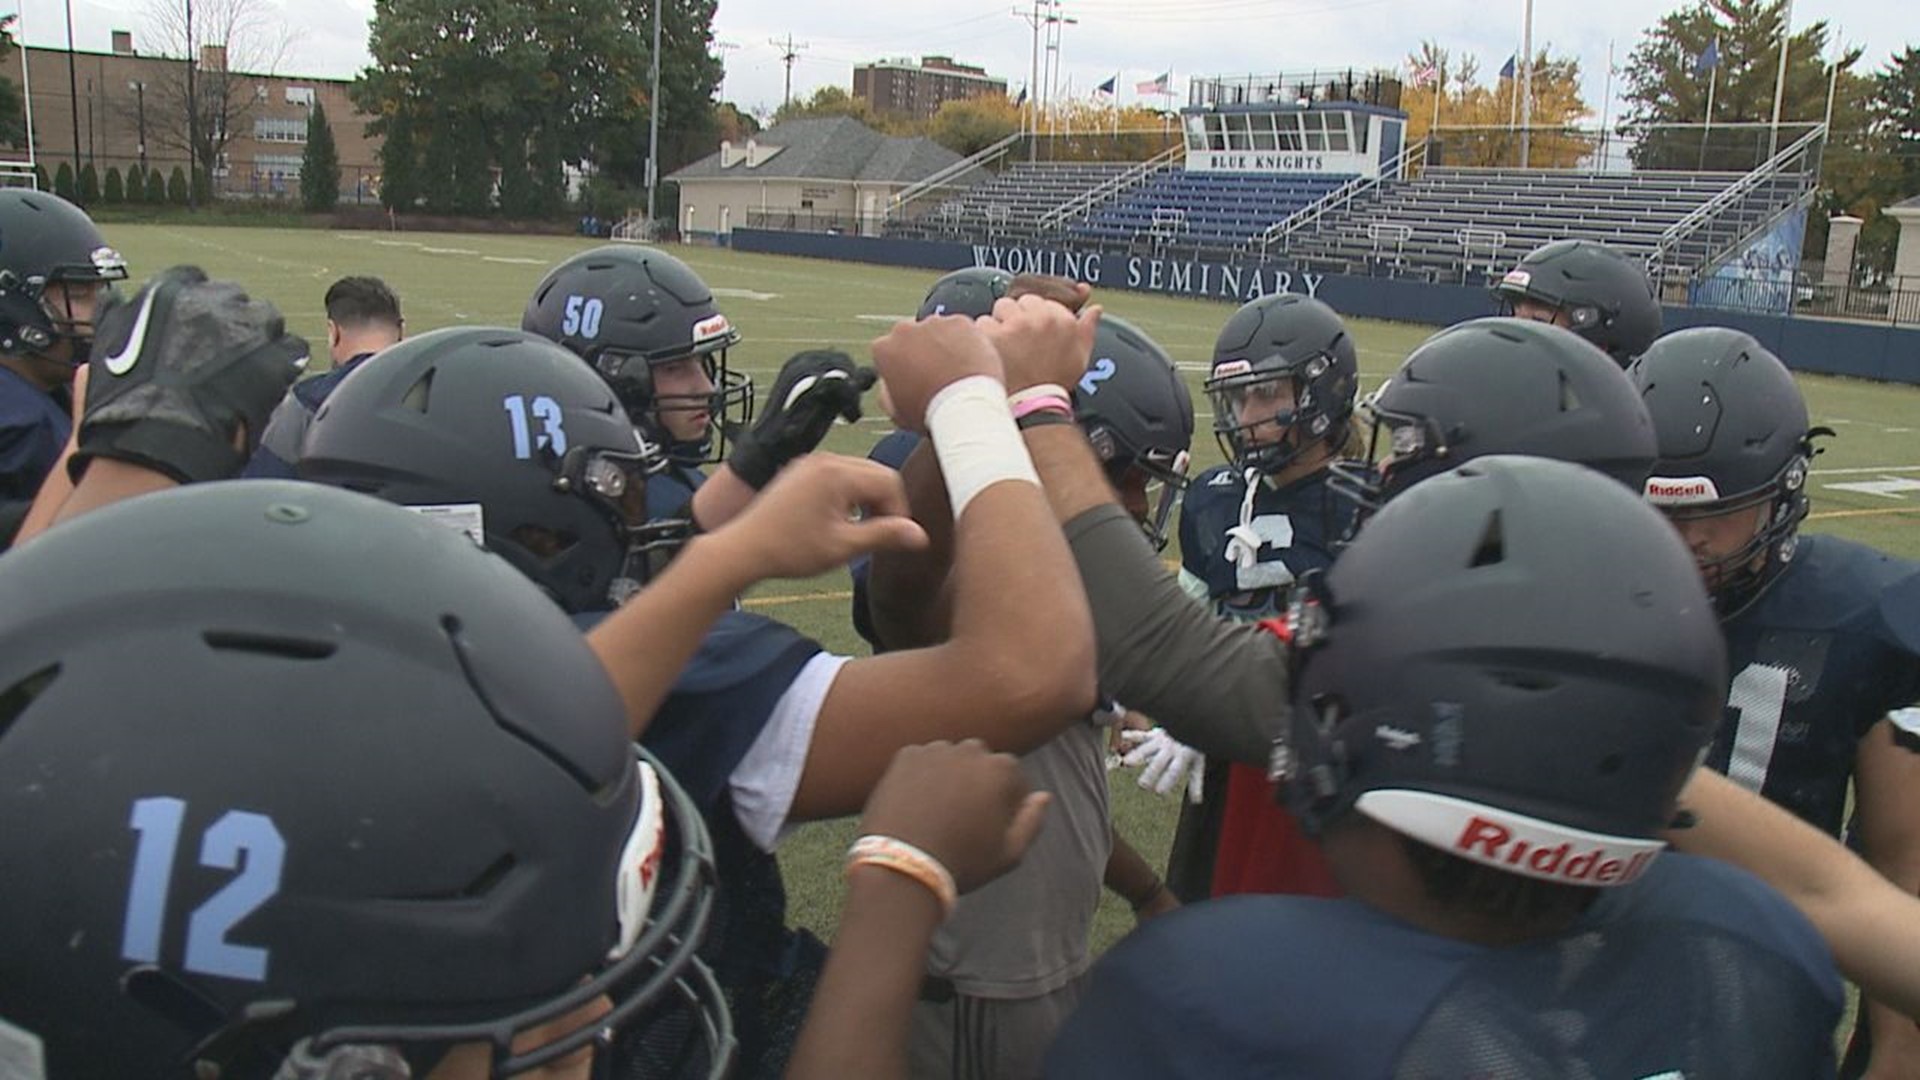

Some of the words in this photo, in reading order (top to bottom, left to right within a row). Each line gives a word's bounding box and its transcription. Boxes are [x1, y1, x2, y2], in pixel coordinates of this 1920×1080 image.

[1210, 156, 1246, 169] BLUE
[1255, 156, 1323, 170] KNIGHTS
[972, 244, 1101, 283] WYOMING
[1127, 257, 1324, 300] SEMINARY
[562, 295, 604, 339] 50
[1079, 358, 1116, 396] 2
[503, 395, 567, 460] 13
[1727, 662, 1789, 795] 1
[1455, 816, 1658, 882] Riddell
[121, 796, 287, 982] 12
